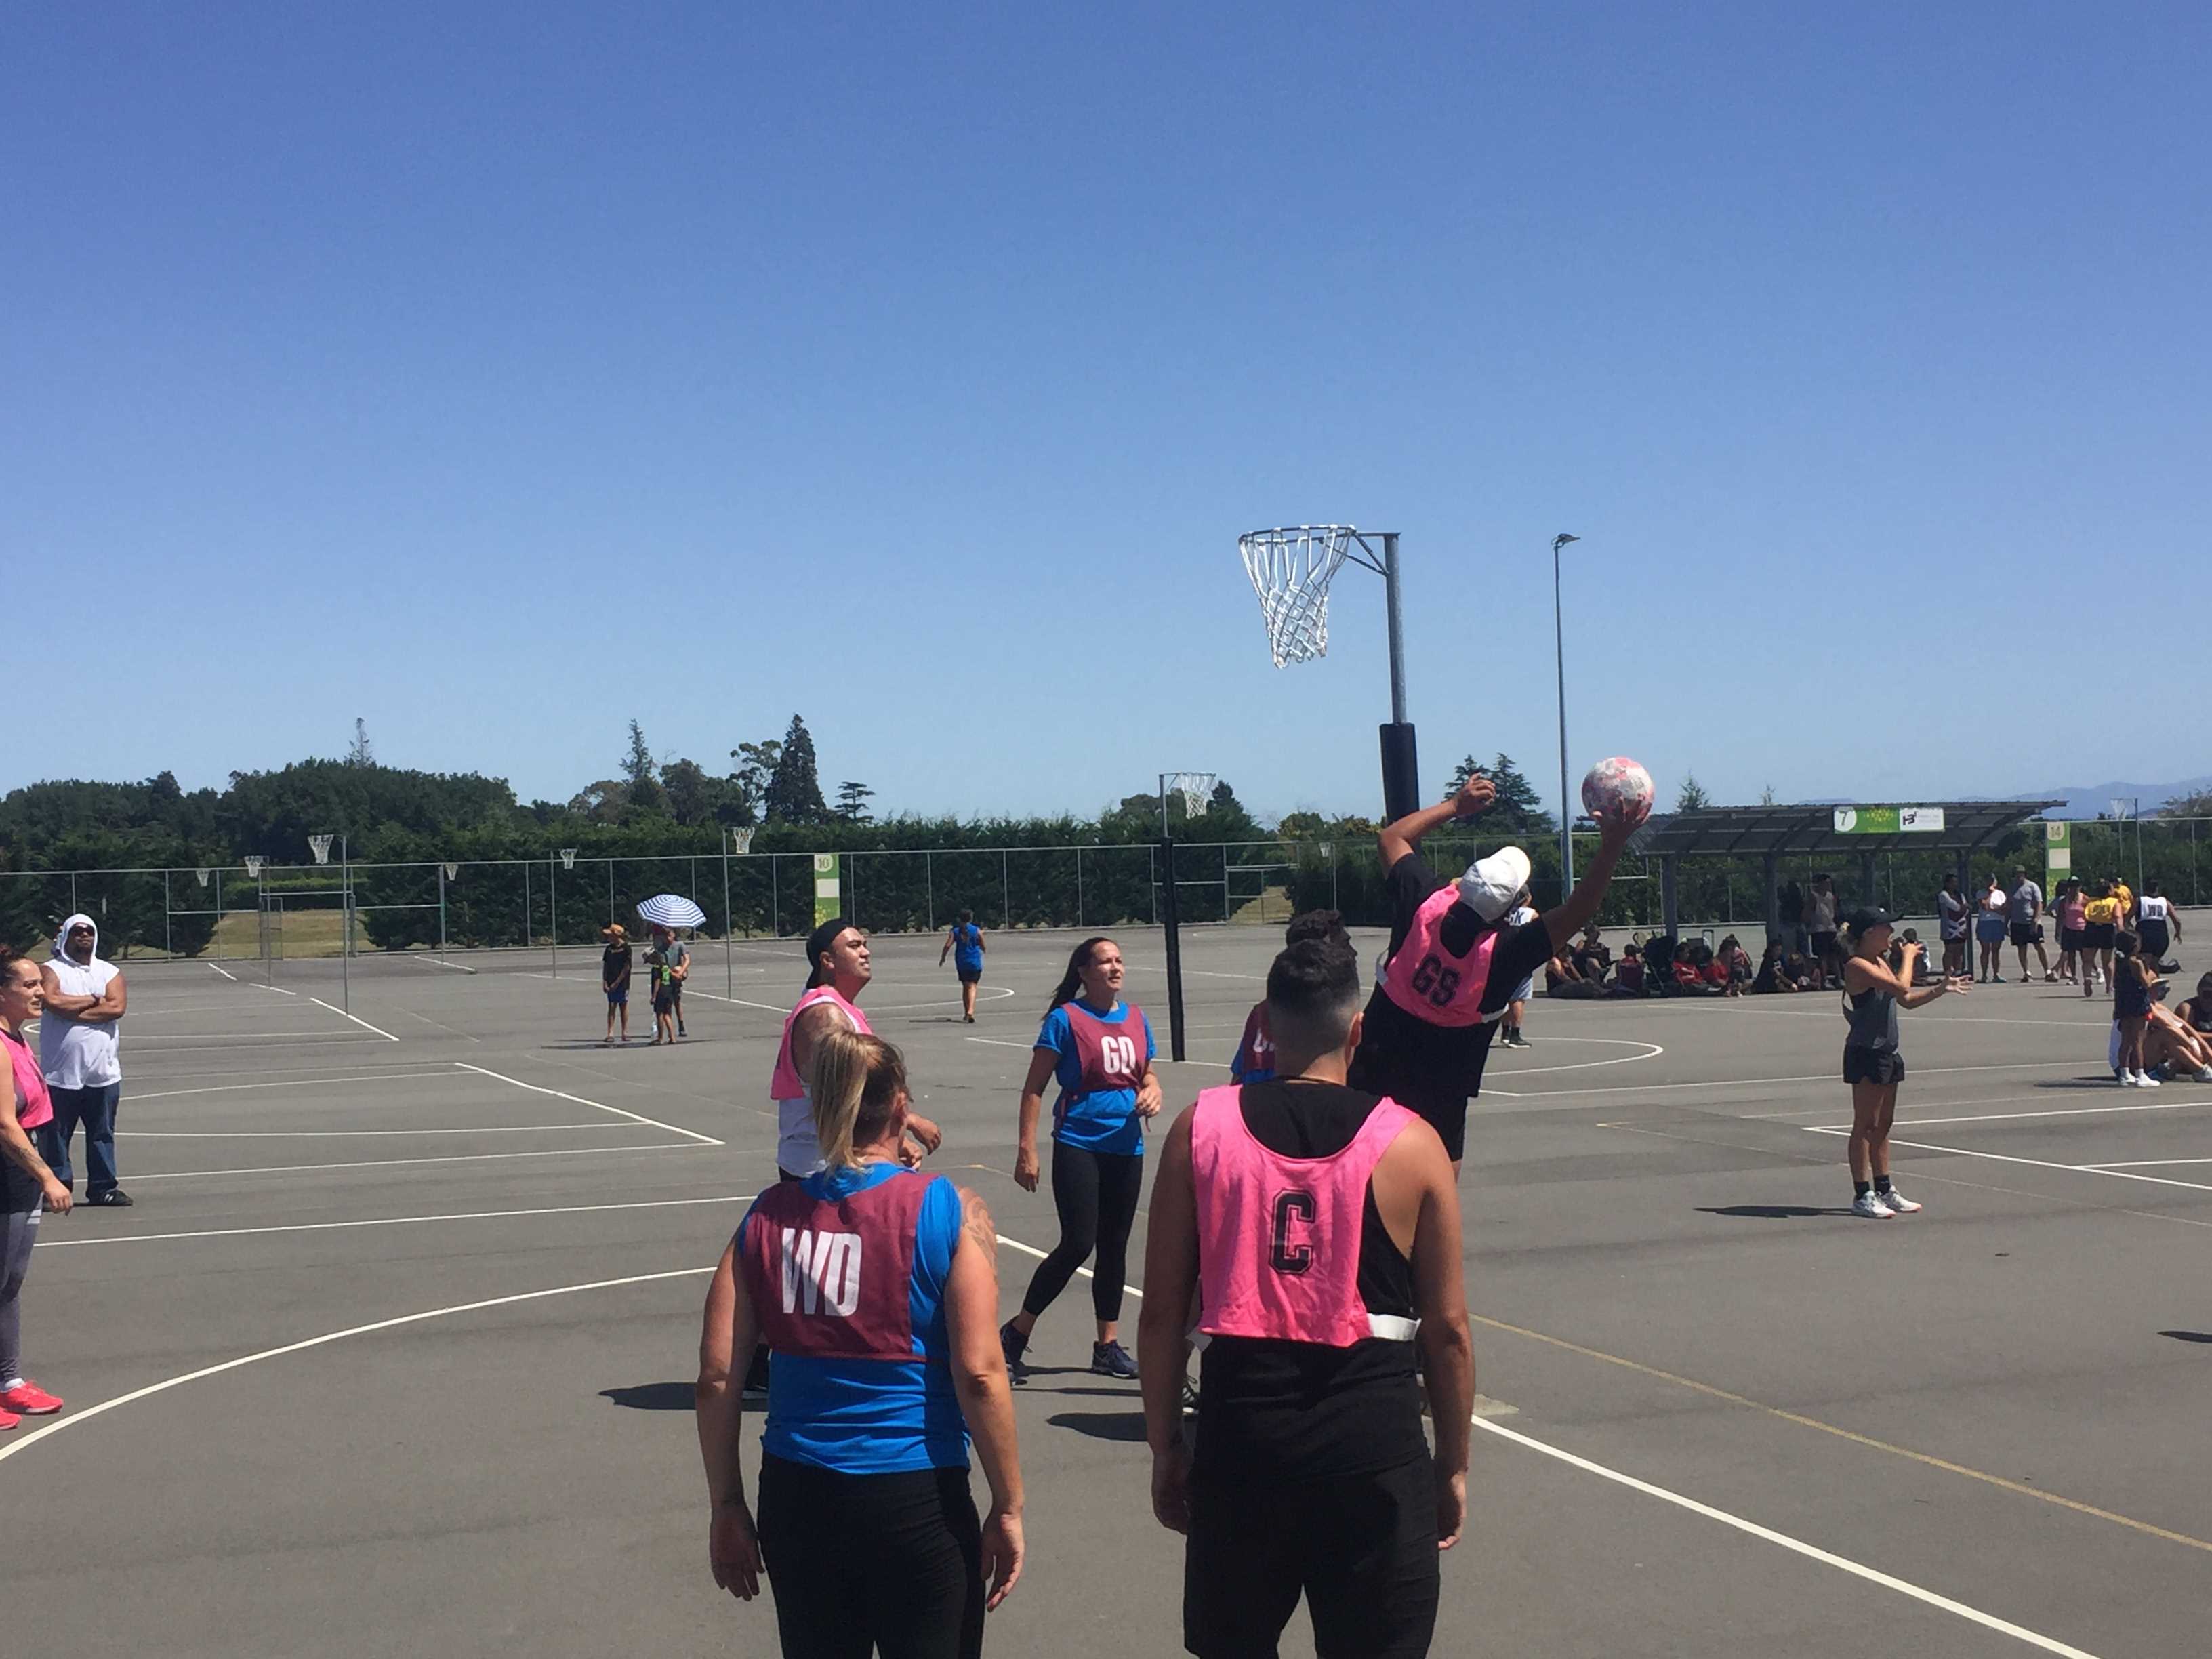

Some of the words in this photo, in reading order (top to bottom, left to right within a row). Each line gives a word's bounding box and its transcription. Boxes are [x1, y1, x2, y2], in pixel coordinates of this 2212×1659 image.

[1839, 811, 1847, 826] 7
[2051, 826, 2061, 838] 14
[819, 857, 830, 869] 10
[1412, 953, 1461, 1008] GS
[1101, 1036, 1136, 1074] GD
[1269, 1189, 1316, 1275] C
[781, 1227, 862, 1317] WD
